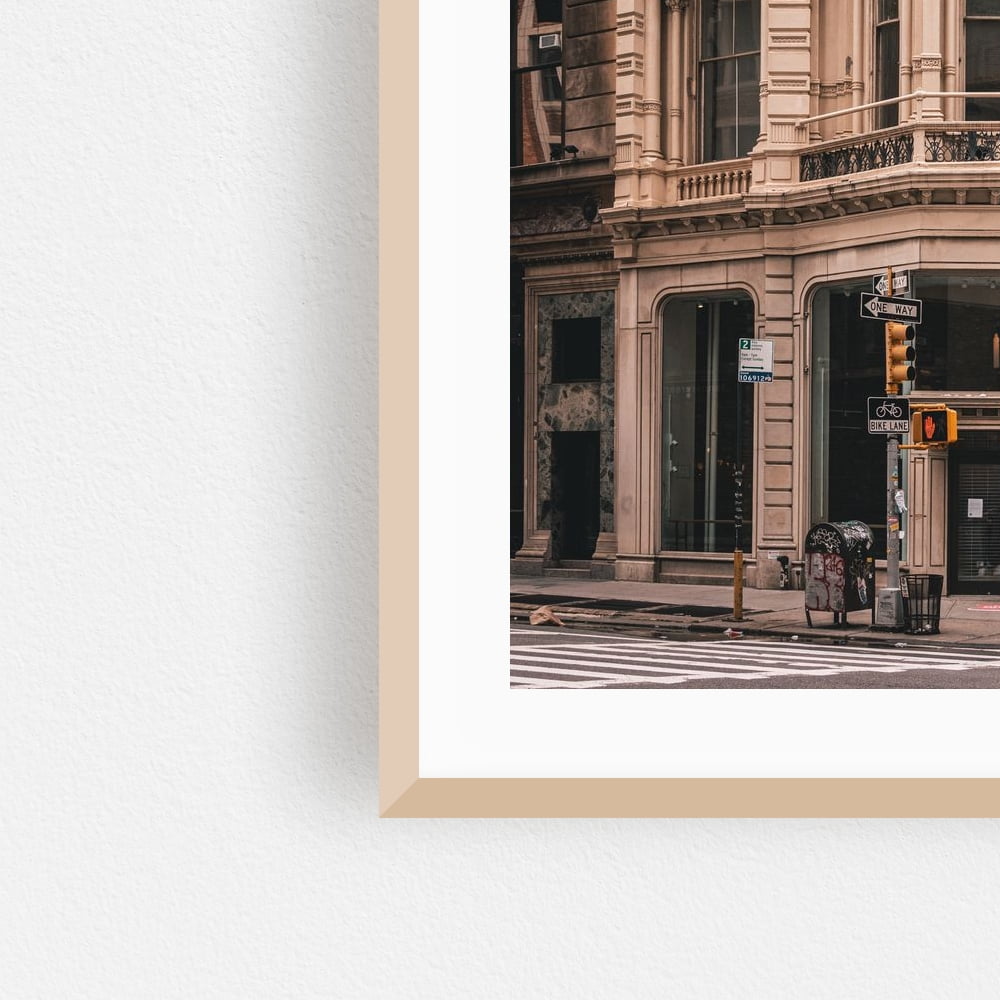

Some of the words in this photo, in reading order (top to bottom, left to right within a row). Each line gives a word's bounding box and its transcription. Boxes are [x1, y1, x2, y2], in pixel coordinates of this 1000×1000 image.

[870, 301, 888, 312] ONE
[895, 304, 913, 315] WAY
[742, 340, 749, 349] 2
[871, 421, 887, 430] BIKE
[890, 421, 908, 430] LANE
